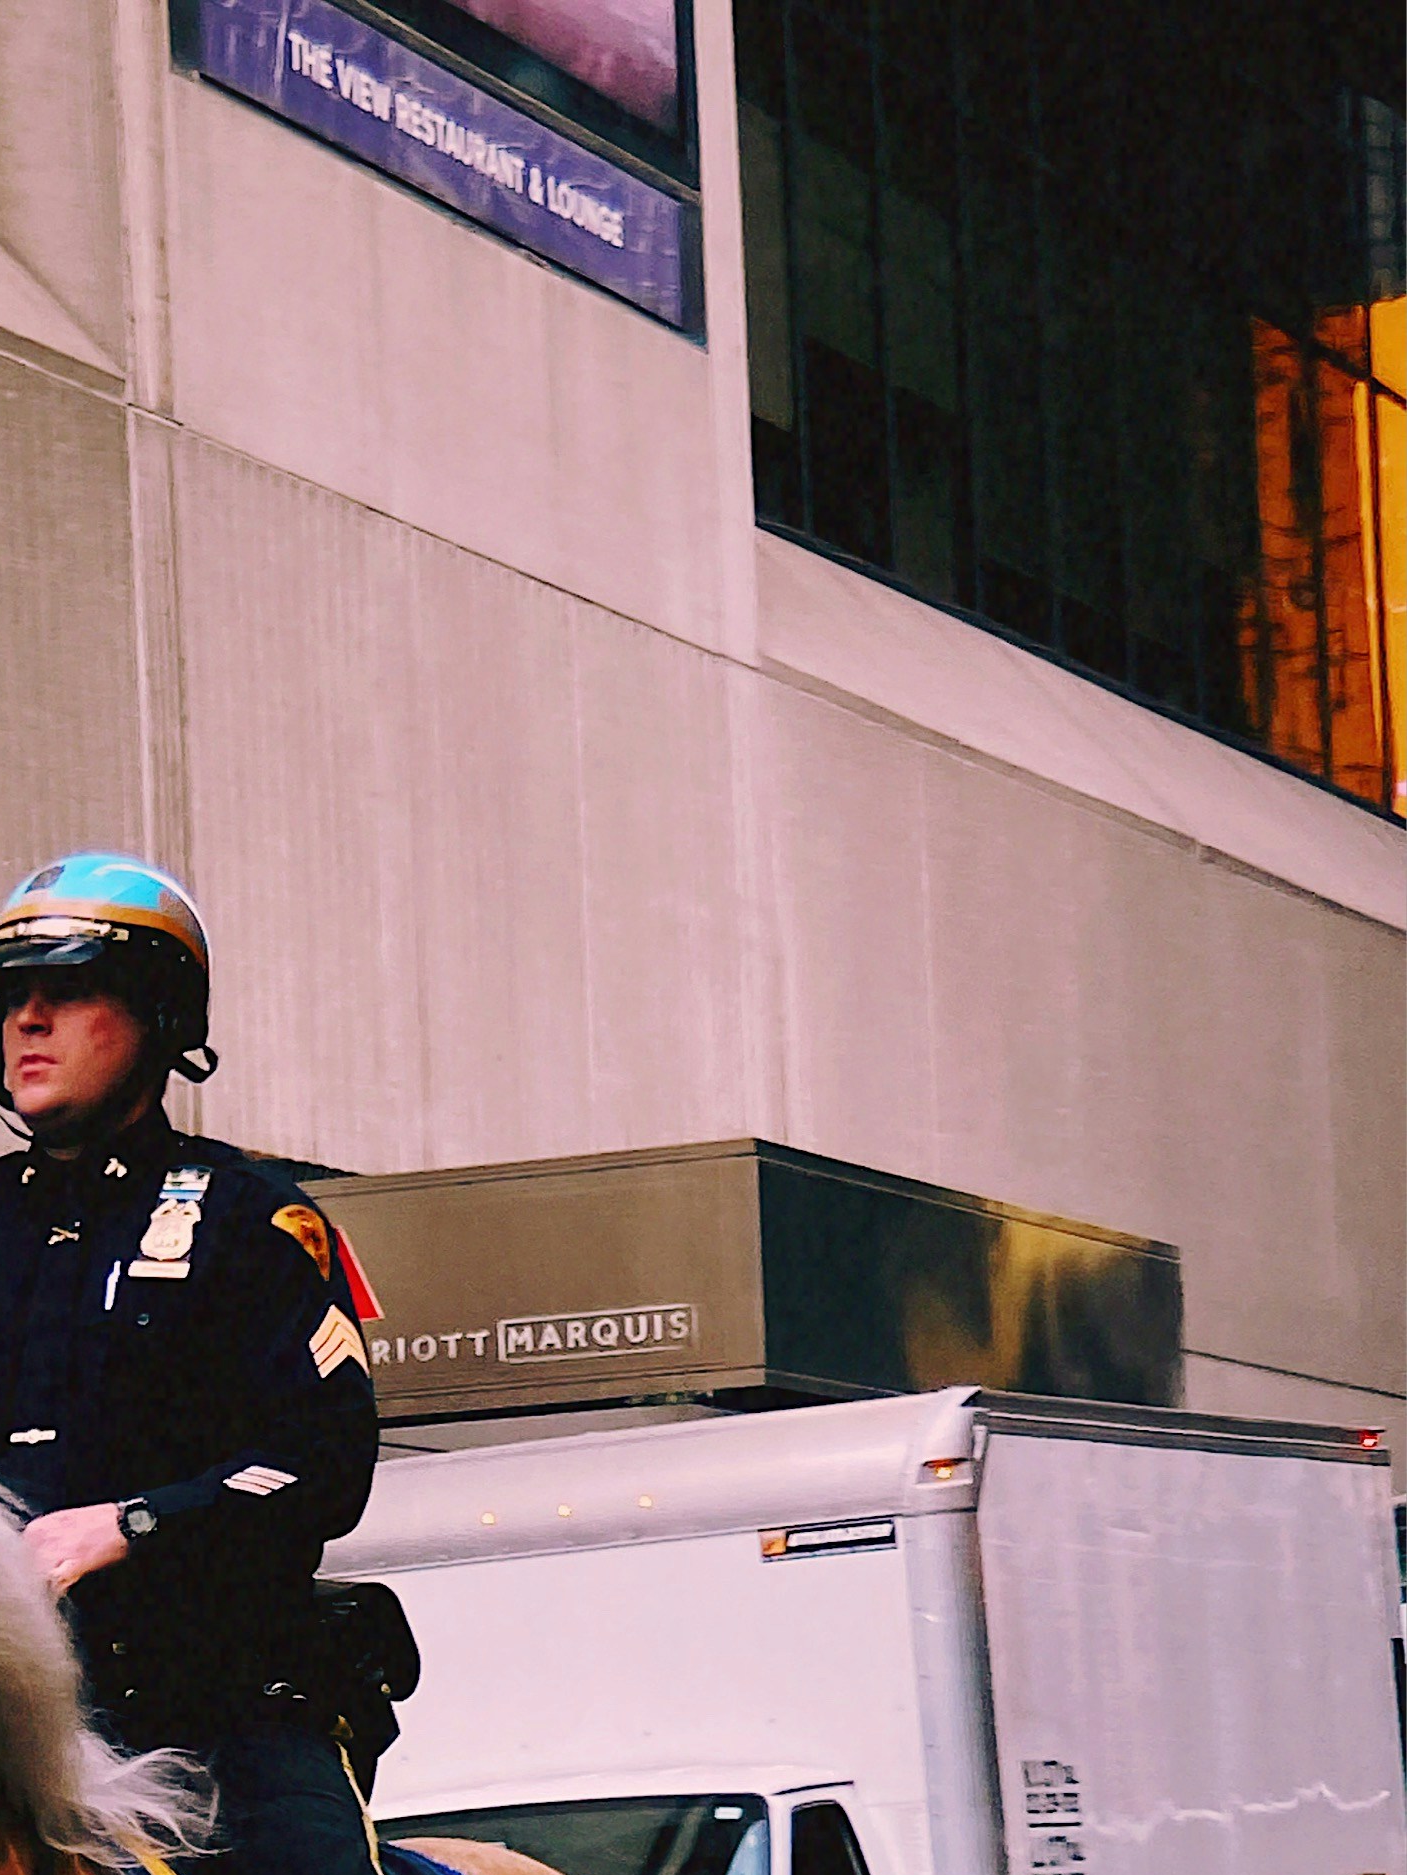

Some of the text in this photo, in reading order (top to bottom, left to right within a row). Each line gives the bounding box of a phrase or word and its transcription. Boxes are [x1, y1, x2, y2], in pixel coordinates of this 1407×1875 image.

[288, 31, 625, 248] THE VIEW RESTAURANT & LOUNGE
[507, 1310, 690, 1354] MARQUIS
